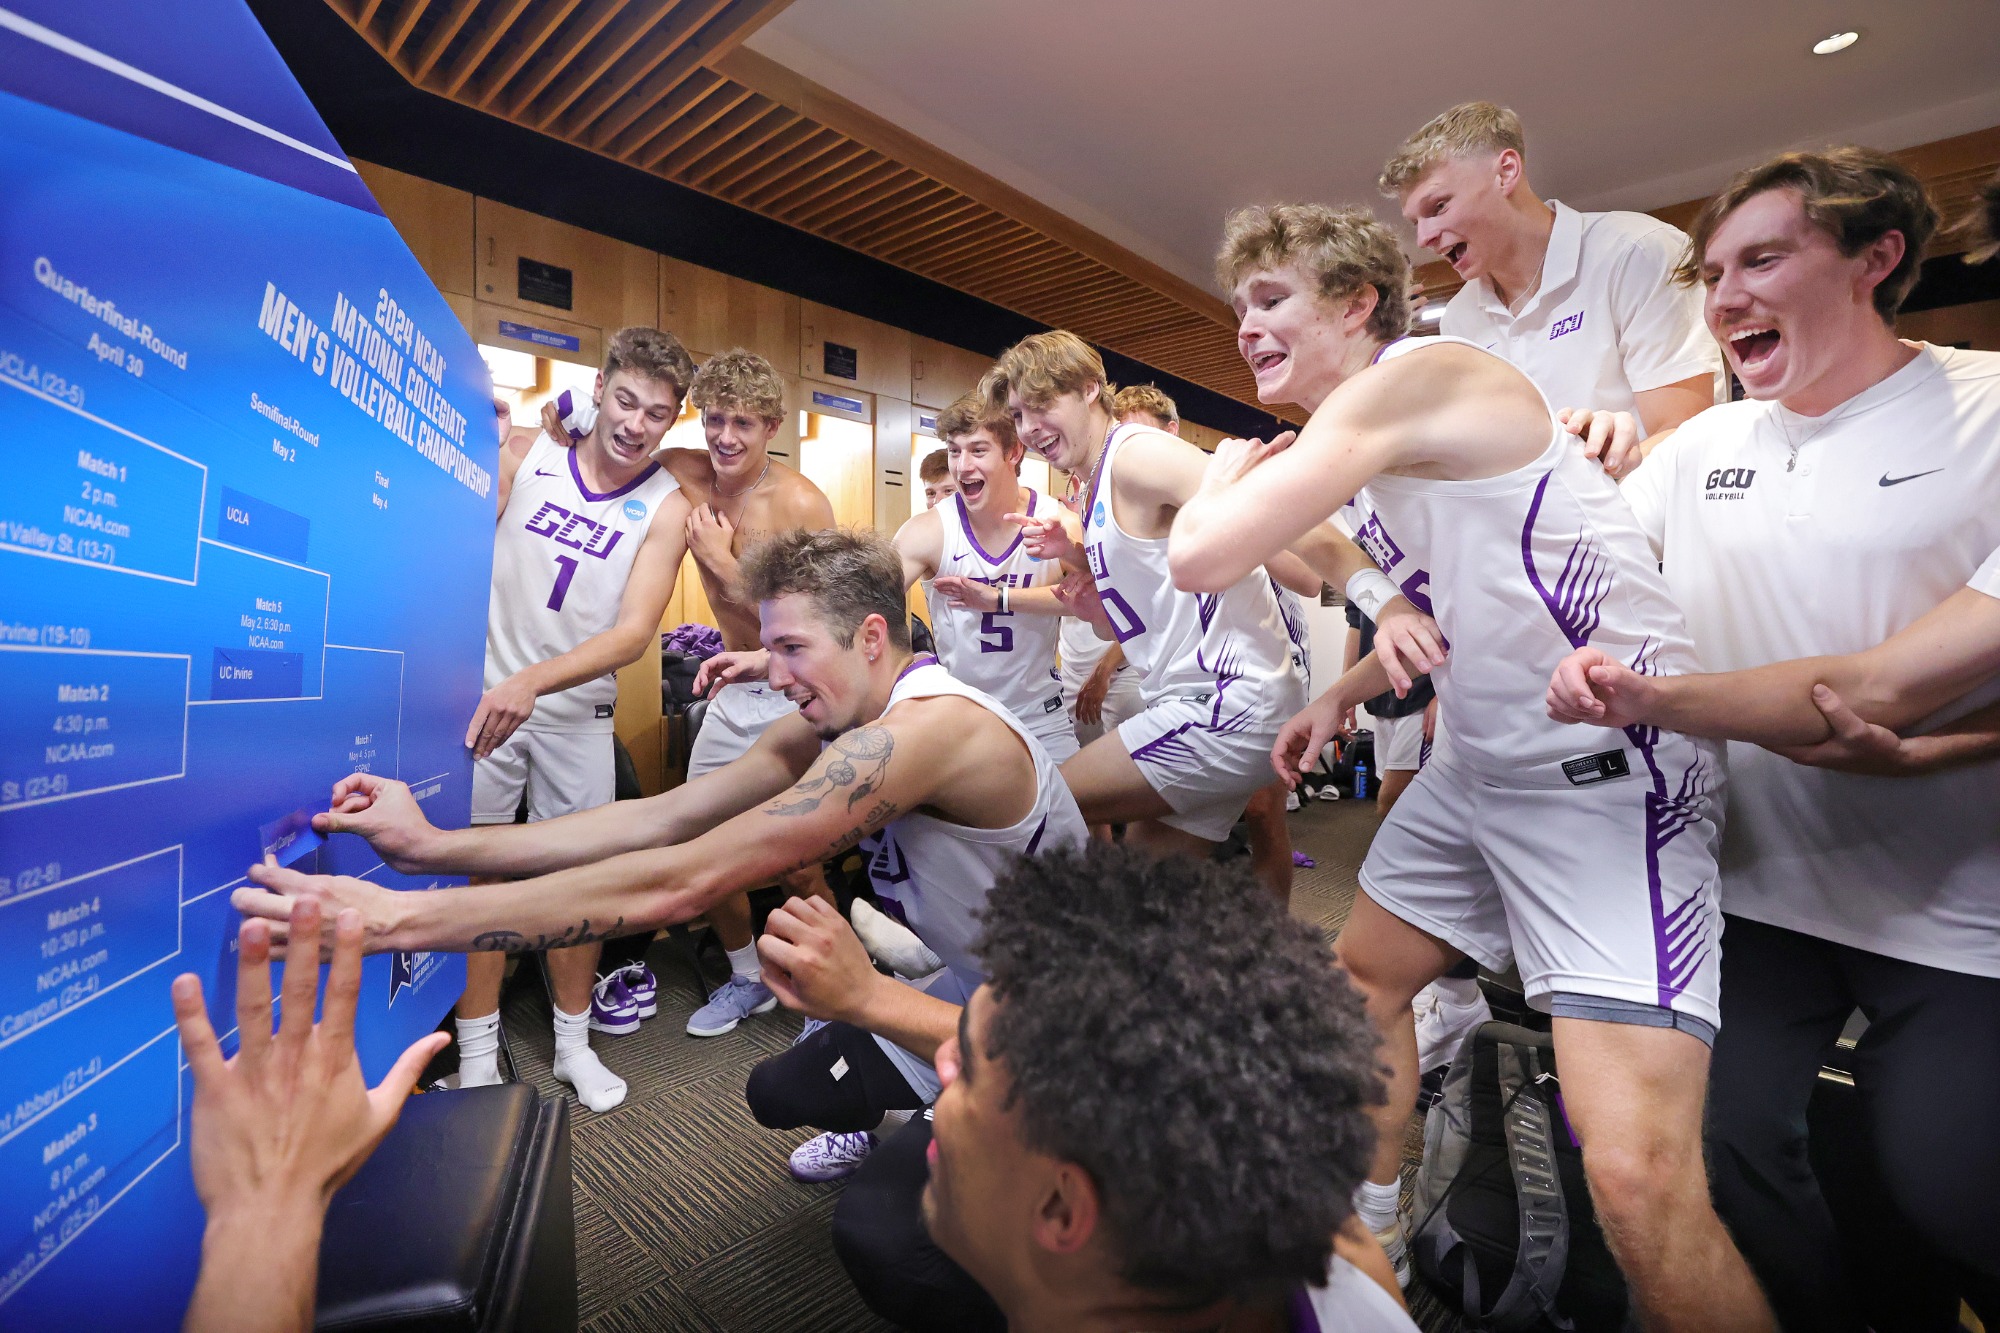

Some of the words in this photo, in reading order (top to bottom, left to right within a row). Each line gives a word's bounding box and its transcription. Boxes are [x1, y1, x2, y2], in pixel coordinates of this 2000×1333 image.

[34, 256, 187, 371] Quarterfinal-Round
[375, 288, 414, 355] 2024
[1550, 310, 1585, 340] GCU
[87, 332, 125, 367] April
[126, 353, 144, 378] 30
[331, 291, 404, 393] NATIONAL
[405, 366, 467, 447] COLLEGIATE
[258, 281, 329, 377] MEN'S
[330, 345, 416, 447] VOLLEYBALL
[417, 421, 491, 499] CHAMPIONSHIP
[250, 392, 320, 448] Semifinal-Round
[272, 438, 289, 462] May
[289, 449, 296, 462] 2
[78, 449, 118, 480] Match
[119, 466, 126, 482] 1
[81, 481, 91, 500] 2
[375, 470, 389, 489] Final
[1705, 468, 1756, 491] GCU
[372, 493, 384, 509] May
[383, 498, 388, 510] 4
[1705, 492, 1745, 501] VOLLEYBALL
[63, 505, 131, 538] NCAA.com
[227, 506, 249, 526] UCLA
[10, 521, 56, 552] Valley
[524, 500, 626, 560] GCU
[546, 554, 579, 613] 1
[256, 598, 276, 613] Match
[277, 602, 283, 614] 5
[241, 614, 256, 632] May
[981, 610, 1014, 654] 5
[248, 635, 284, 650] NCAA.com
[219, 666, 233, 679] UC
[233, 666, 253, 680] Irvine
[58, 684, 100, 703] Match
[100, 684, 110, 701] 2
[45, 742, 115, 764] NCAA.com
[1607, 759, 1618, 770] L
[47, 901, 91, 931] Match
[91, 896, 101, 914] 4
